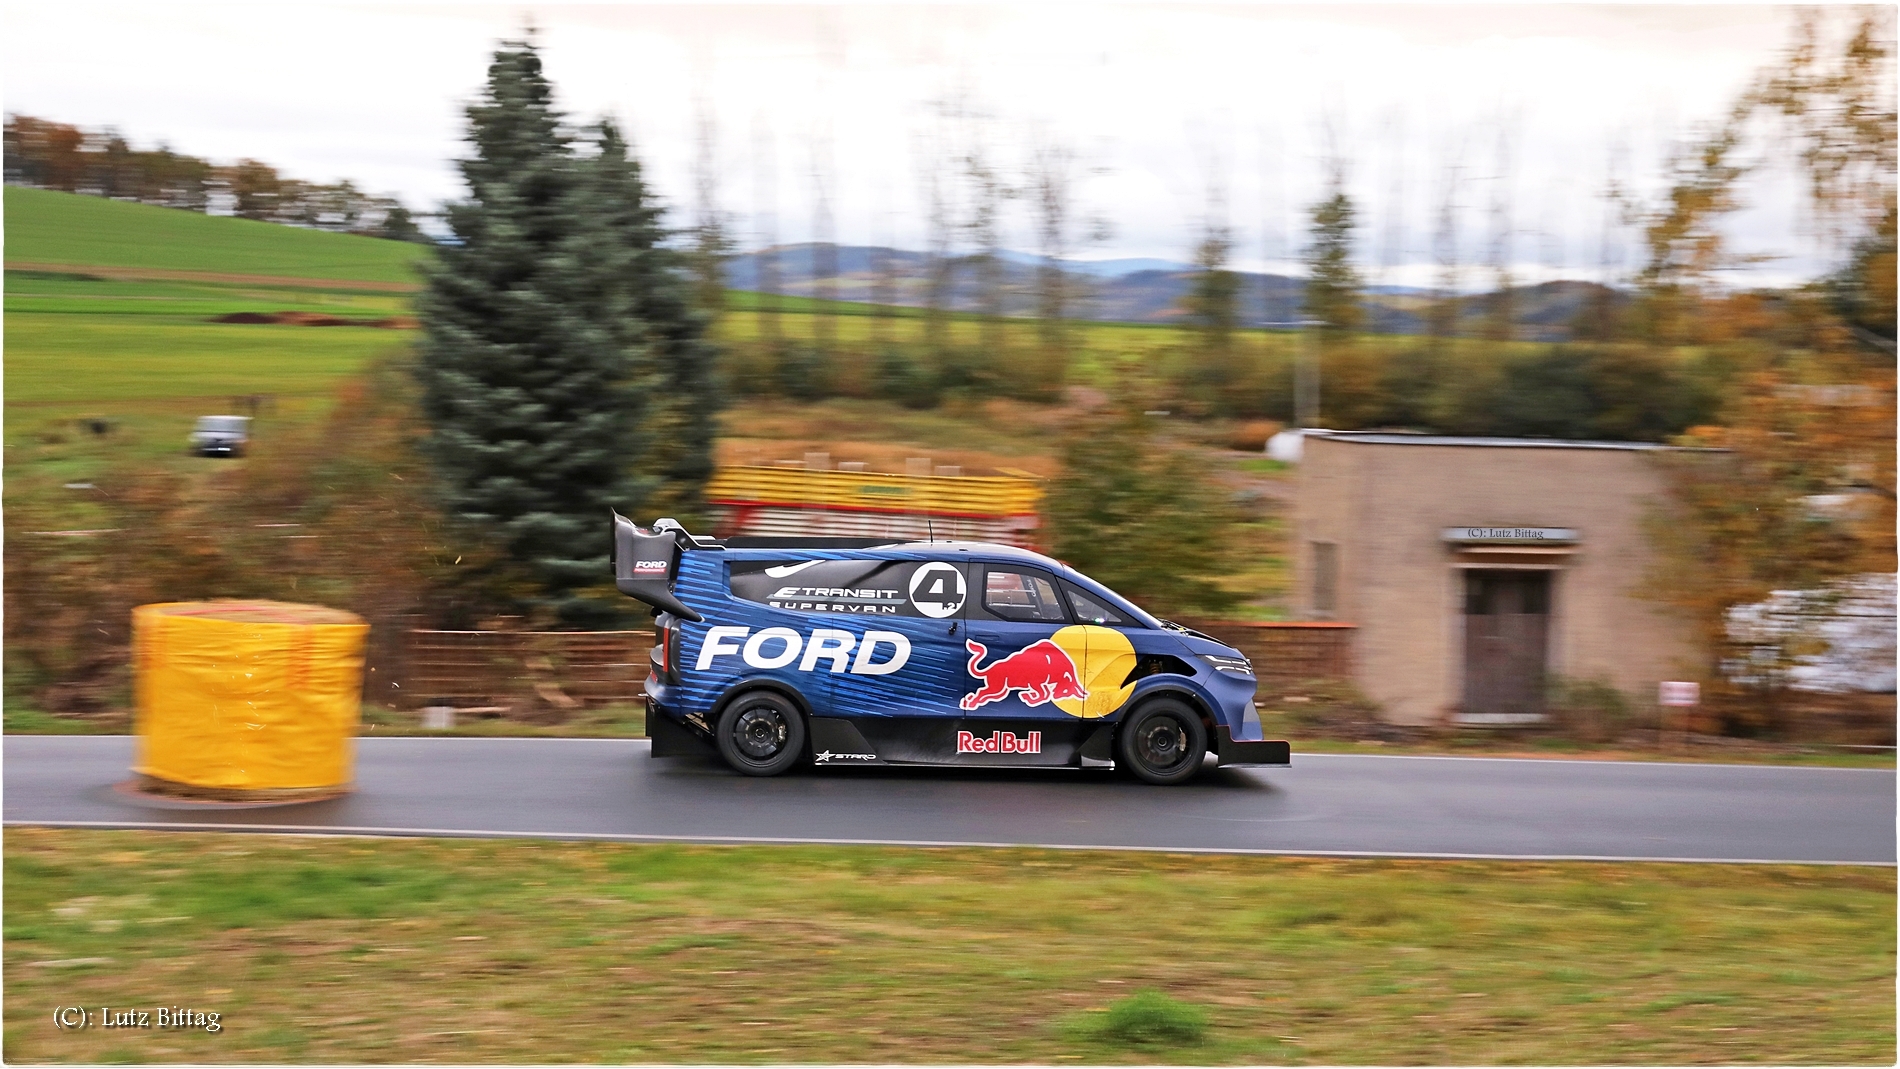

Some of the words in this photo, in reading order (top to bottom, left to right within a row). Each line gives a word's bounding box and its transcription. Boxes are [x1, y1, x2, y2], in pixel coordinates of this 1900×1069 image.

[769, 601, 896, 613] SUPERVAN
[695, 626, 911, 675] FORD
[958, 731, 1000, 753] Red
[1001, 731, 1041, 753] Bull
